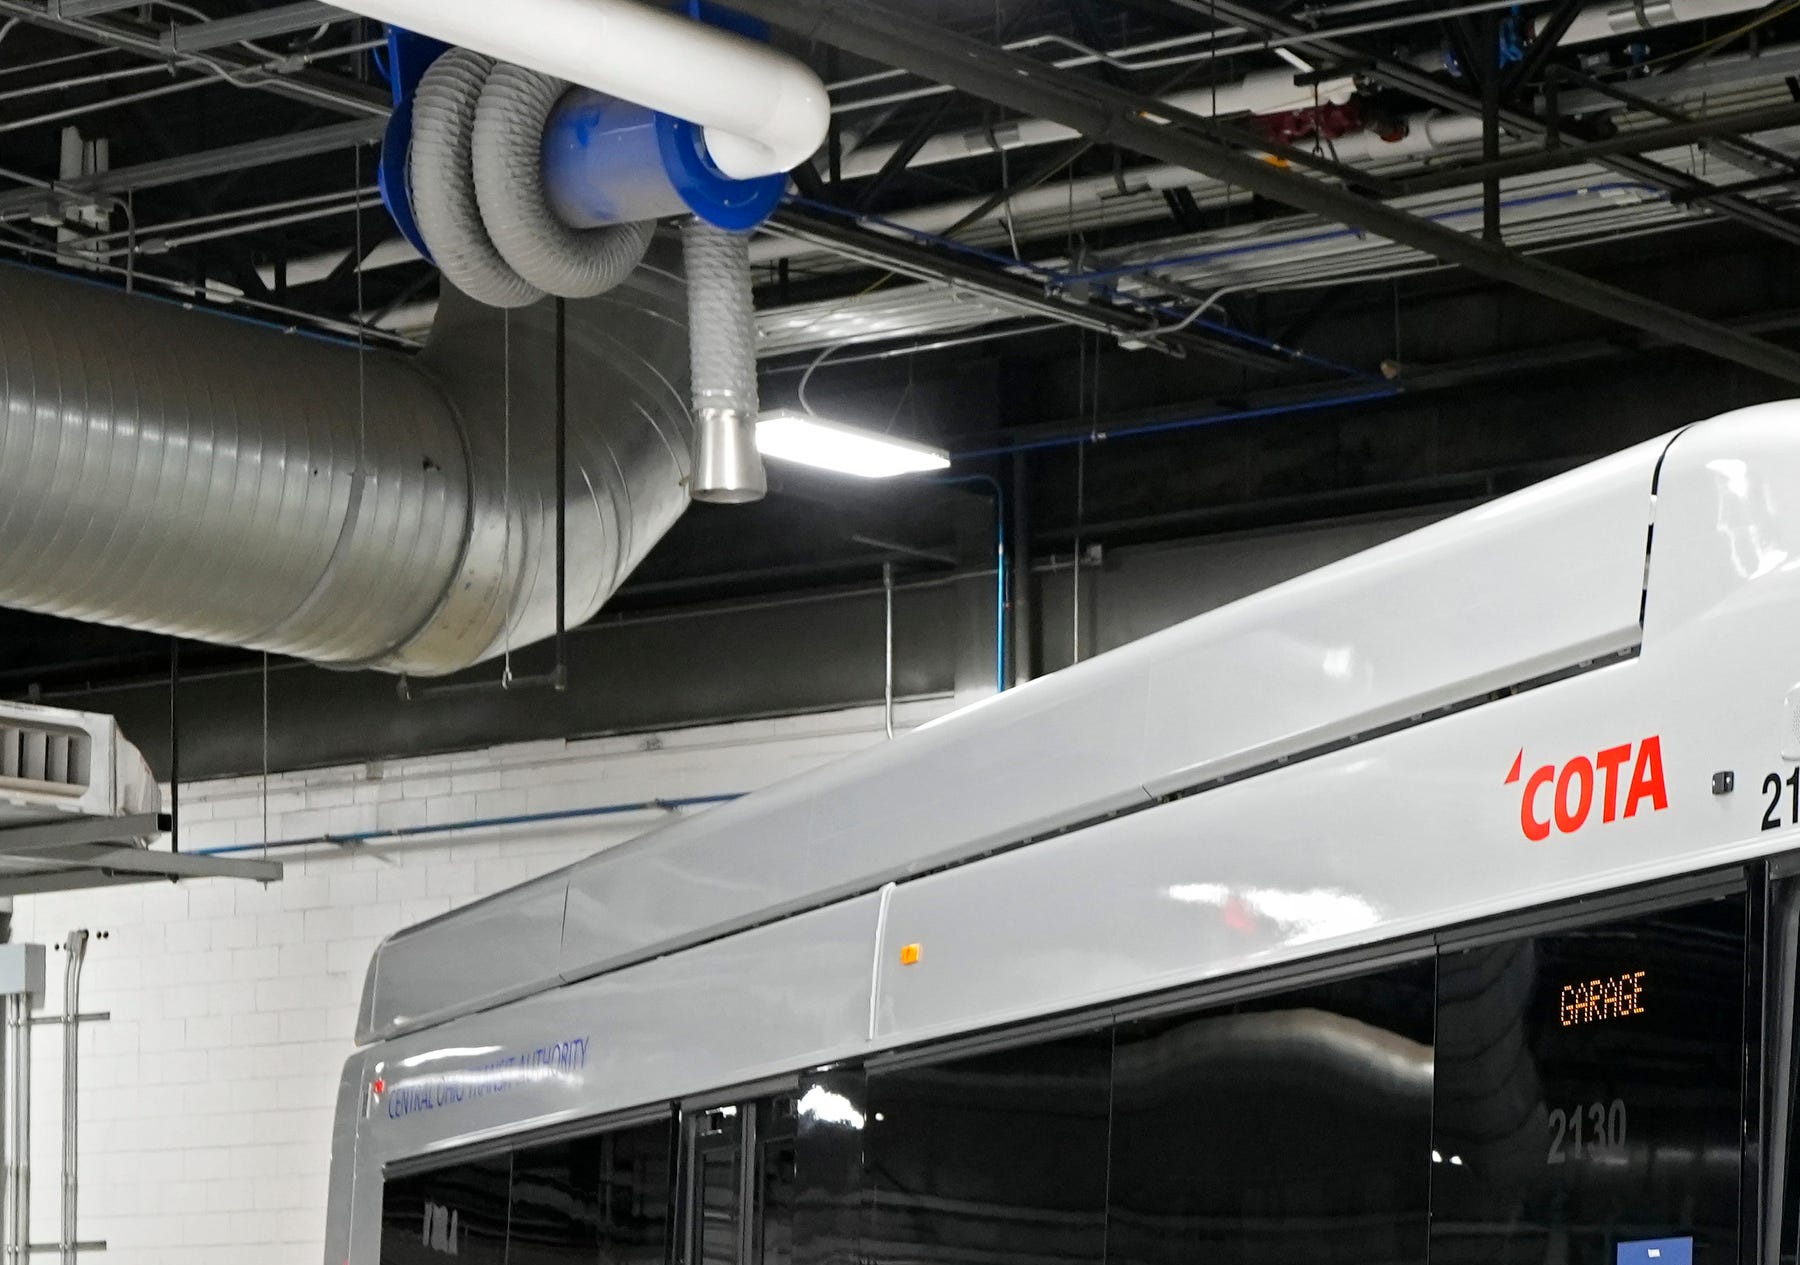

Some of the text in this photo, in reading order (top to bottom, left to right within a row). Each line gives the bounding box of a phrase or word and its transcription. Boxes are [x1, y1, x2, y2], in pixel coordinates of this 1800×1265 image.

[1520, 734, 1669, 842] COTA
[1560, 970, 1646, 1027] GARAGE
[388, 1079, 433, 1119] CENTRAL
[521, 1036, 590, 1084] AUTHORITY
[1547, 1098, 1627, 1165] 2130
